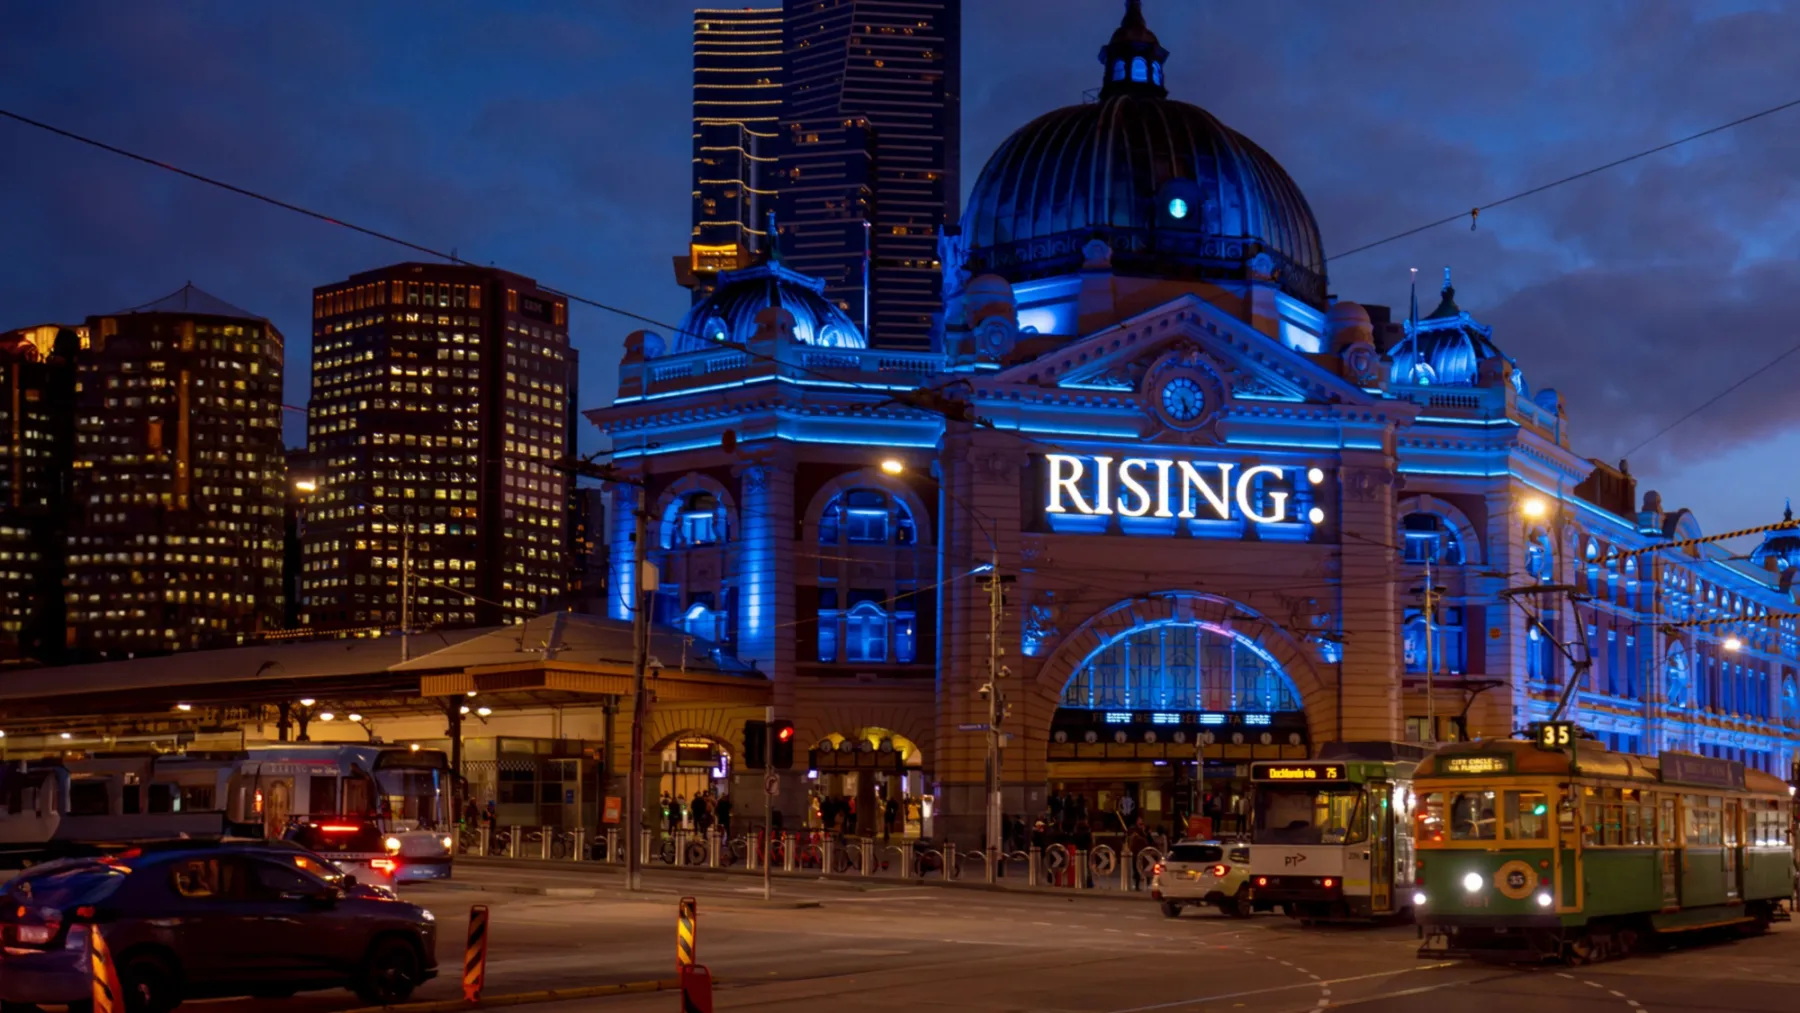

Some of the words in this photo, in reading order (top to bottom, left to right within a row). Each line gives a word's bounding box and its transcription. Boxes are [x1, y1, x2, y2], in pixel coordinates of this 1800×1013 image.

[1543, 726, 1570, 745] 35
[1304, 768, 1316, 779] via
[1325, 767, 1337, 779] 75
